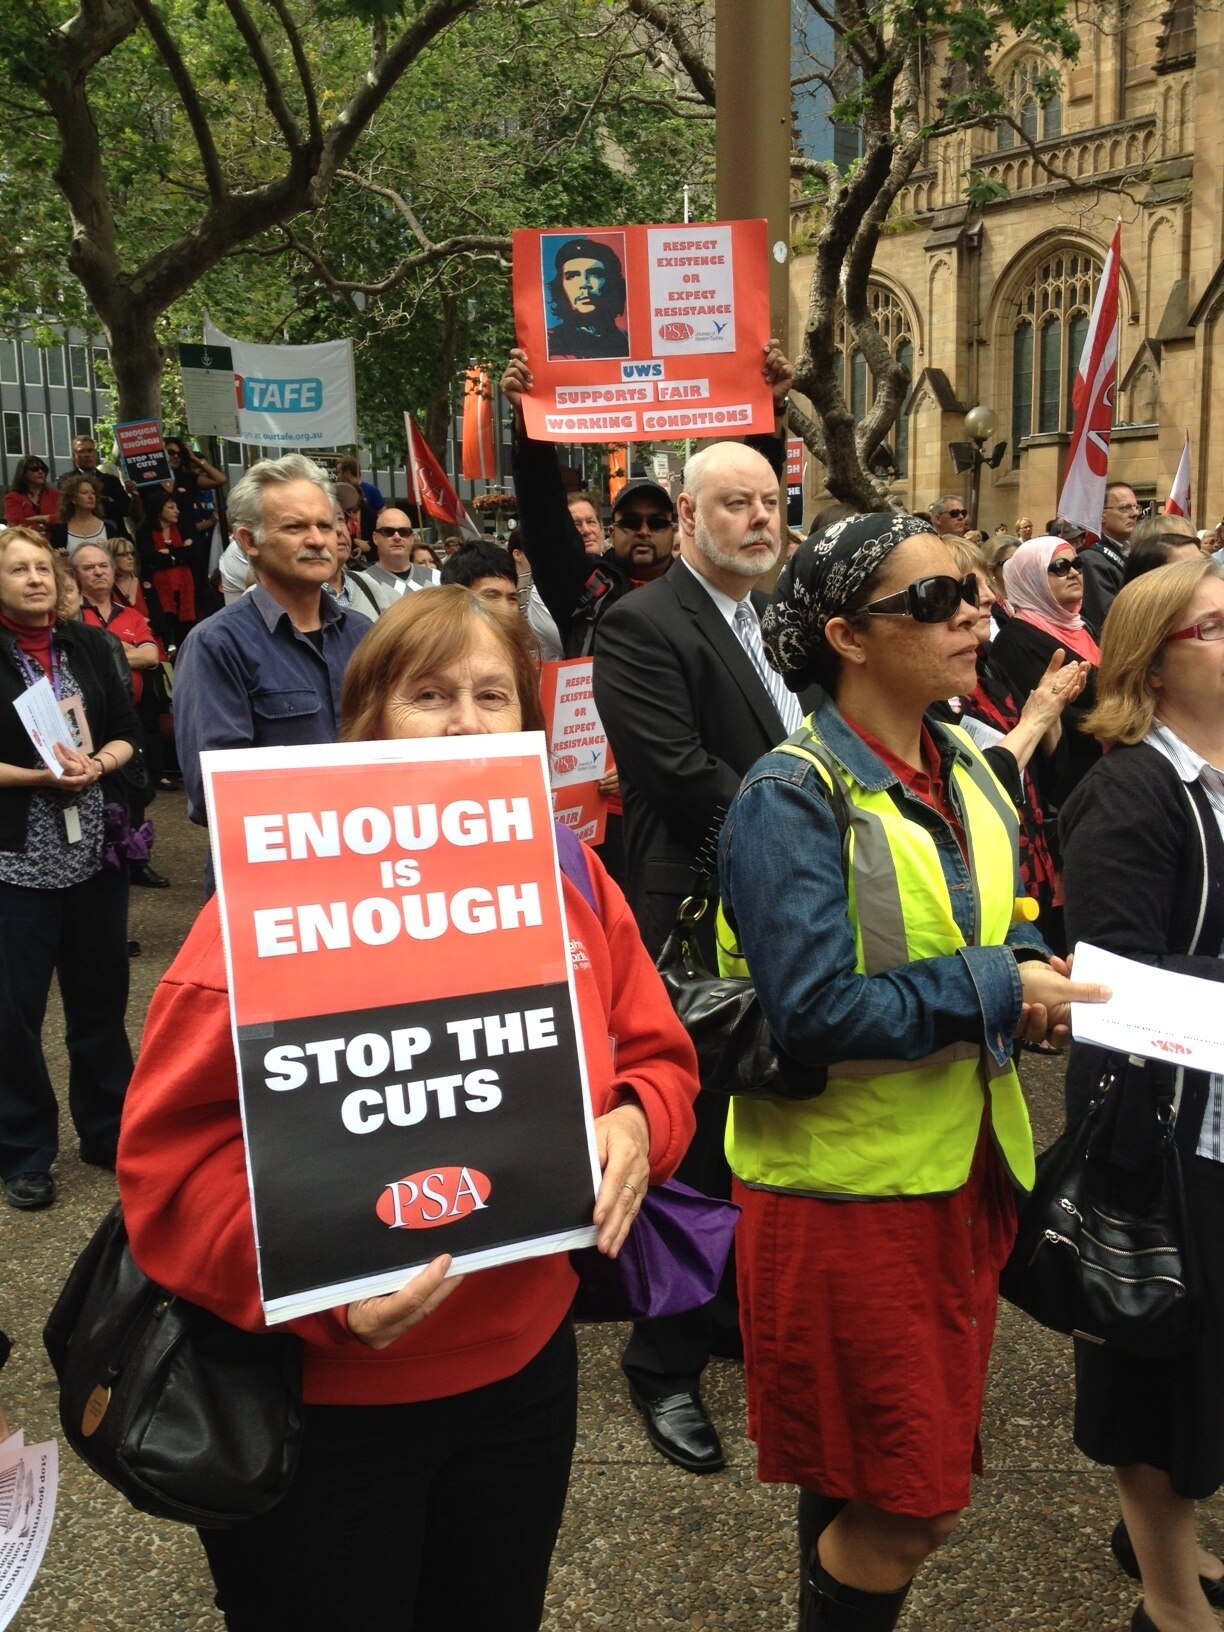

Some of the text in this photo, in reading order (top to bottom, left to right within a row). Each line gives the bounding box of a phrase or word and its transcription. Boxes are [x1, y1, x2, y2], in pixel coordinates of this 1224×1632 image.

[662, 240, 718, 252] RESPECT
[656, 255, 725, 268] EXISTENCE
[682, 274, 700, 284] OR
[668, 290, 716, 302] EXPECT
[654, 304, 732, 317] RESISTANCE
[662, 323, 692, 340] PSA
[622, 364, 662, 378] UWS
[250, 382, 316, 408] TAFE
[558, 386, 702, 404] SUPPORTS FAIR
[548, 409, 748, 430] WORKING CONDITIONS
[120, 426, 158, 438] ENOUGH
[123, 437, 160, 448] ENOUGH
[126, 452, 164, 464] STOP THE
[136, 460, 158, 468] CUTS
[566, 676, 593, 688] RESPE
[560, 691, 594, 704] EXISTEN
[574, 708, 586, 717] OR
[564, 722, 596, 735] EXPECT
[553, 735, 606, 751] RESISTANCE
[243, 796, 534, 864] ENOUGH
[380, 858, 422, 888] IS
[253, 882, 543, 958] ENOUGH
[264, 1006, 558, 1092] STOP THE
[341, 1068, 502, 1134] CUTS
[385, 1166, 489, 1229] PSA
[0, 1455, 48, 1601] Stop government incom
